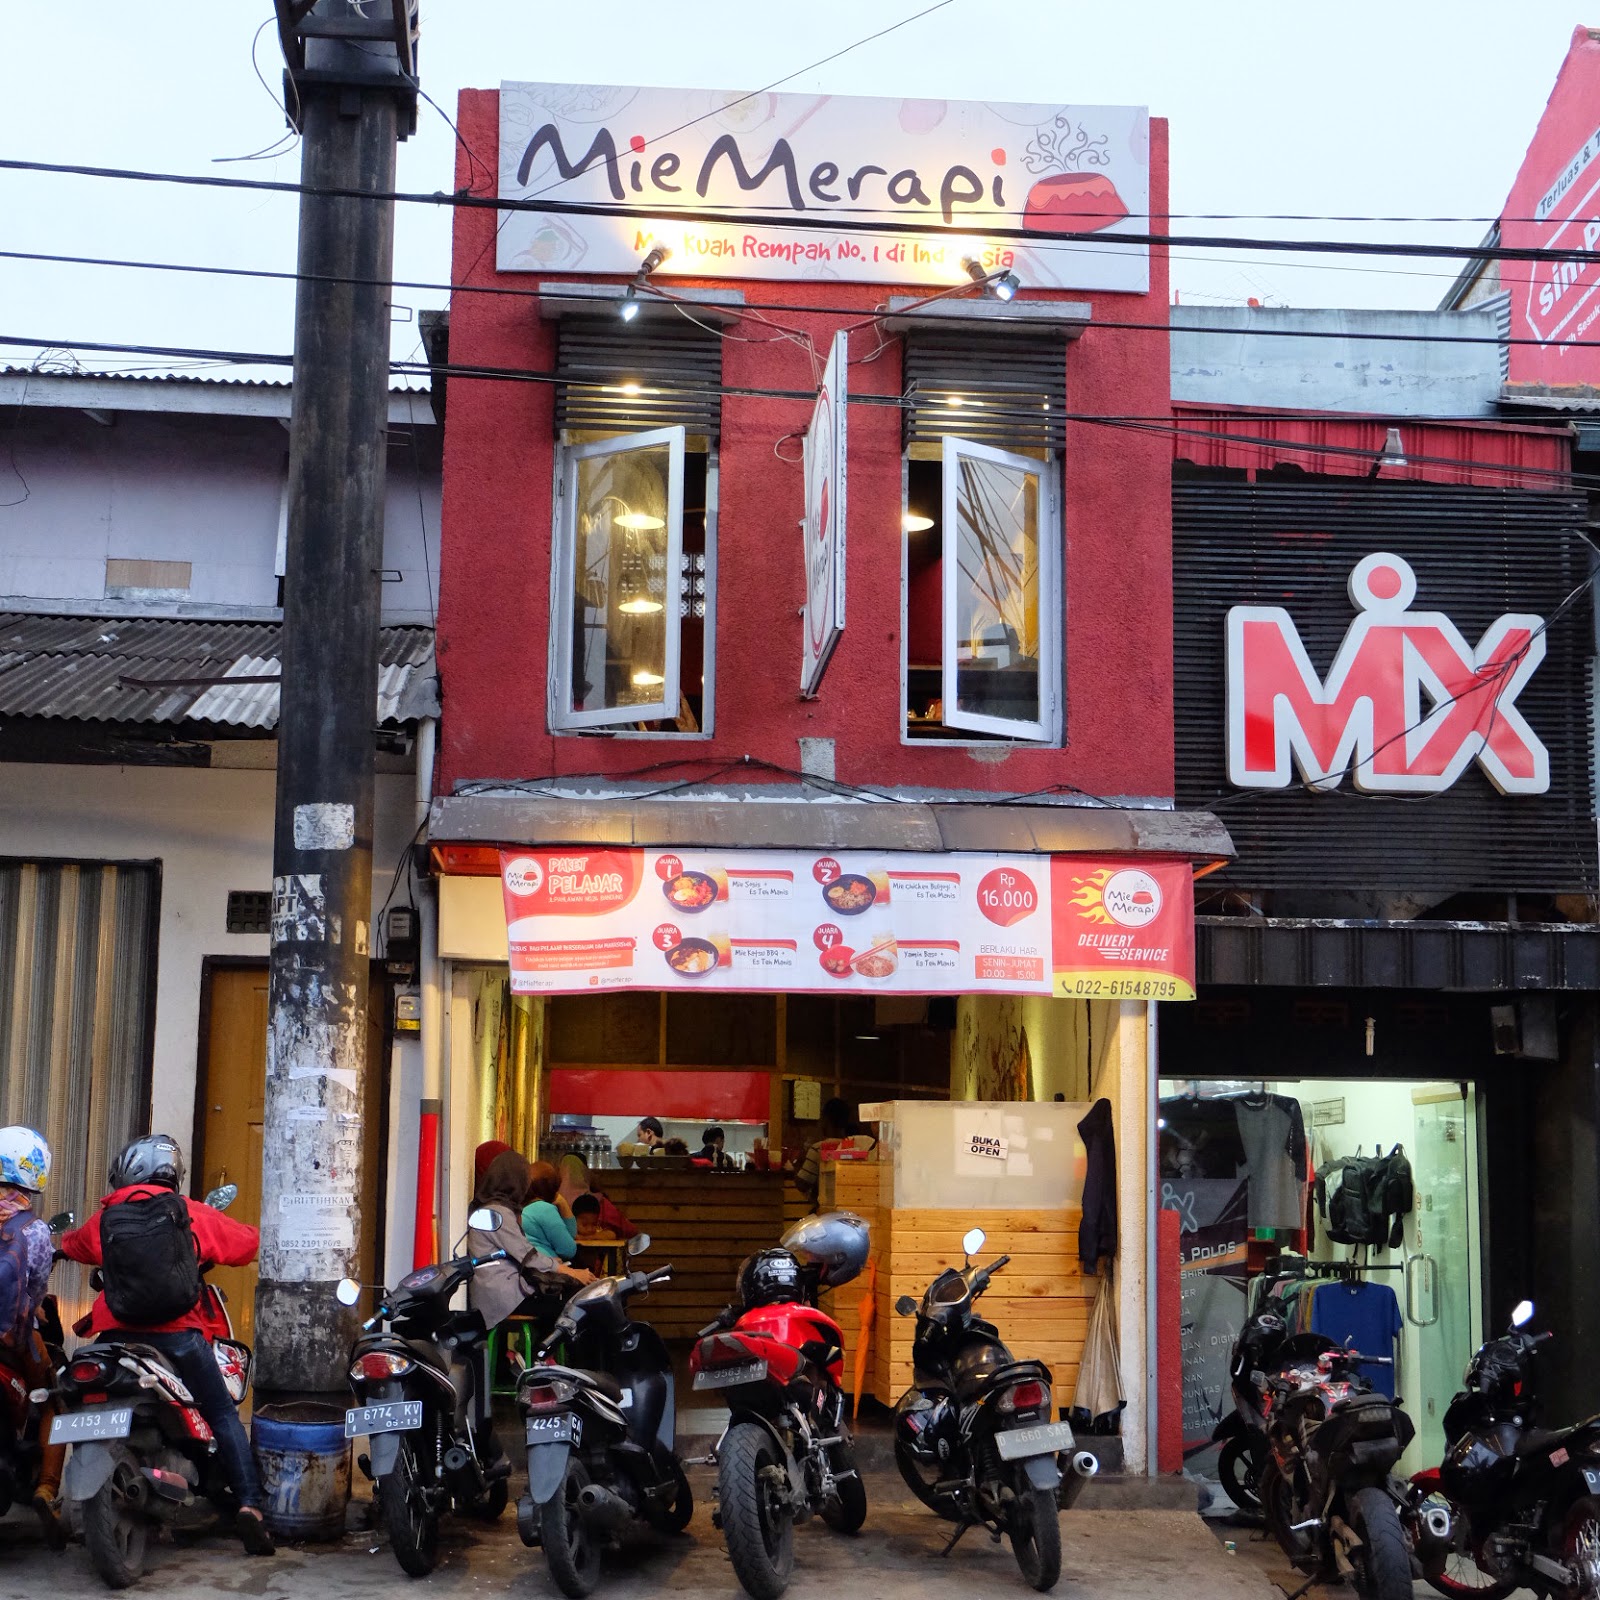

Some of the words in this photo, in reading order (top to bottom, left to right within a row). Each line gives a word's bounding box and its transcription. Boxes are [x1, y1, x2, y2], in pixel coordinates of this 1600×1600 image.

[518, 123, 680, 200] Mie
[696, 134, 1006, 225] Merapi
[1540, 160, 1579, 216] Terluas
[1582, 145, 1591, 164] &
[683, 231, 735, 257] Kuah
[742, 234, 830, 265] Rempah
[837, 240, 866, 262] No.
[886, 243, 905, 262] di
[914, 244, 1014, 268] Indsia
[549, 857, 588, 872] PAKET
[667, 865, 672, 879] 1
[821, 869, 832, 882] 2
[549, 874, 622, 894] PELAJAR
[1000, 873, 1015, 887] Rp
[982, 890, 1033, 908] 16.000
[1108, 890, 1131, 901] Mie
[1112, 902, 1154, 916] Merapi
[662, 934, 672, 947] 3
[822, 935, 833, 949] 4
[1077, 934, 1135, 947] DELIVERY
[980, 945, 1016, 954] BERLAKU
[1019, 946, 1038, 955] HARI
[1120, 948, 1169, 961] SERVICE
[982, 969, 1005, 978] 10.00
[1017, 970, 1036, 979] 15.00
[1075, 979, 1176, 996] 022-61548795
[972, 1135, 1000, 1147] BUKA
[971, 1145, 1000, 1156] OPEN
[281, 1240, 299, 1248] 0852
[301, 1240, 320, 1248] 2191
[1191, 1241, 1236, 1261] POLOS
[1211, 1333, 1240, 1346] DIGITA
[699, 1373, 705, 1381] D
[750, 1362, 763, 1372] MA
[55, 1419, 62, 1431] D
[71, 1414, 101, 1428] 4153
[111, 1411, 127, 1425] KU
[348, 1412, 355, 1424] D
[364, 1406, 392, 1421] 6774
[404, 1404, 420, 1416] KV
[532, 1416, 560, 1430] 4245
[1586, 1471, 1597, 1483] D
